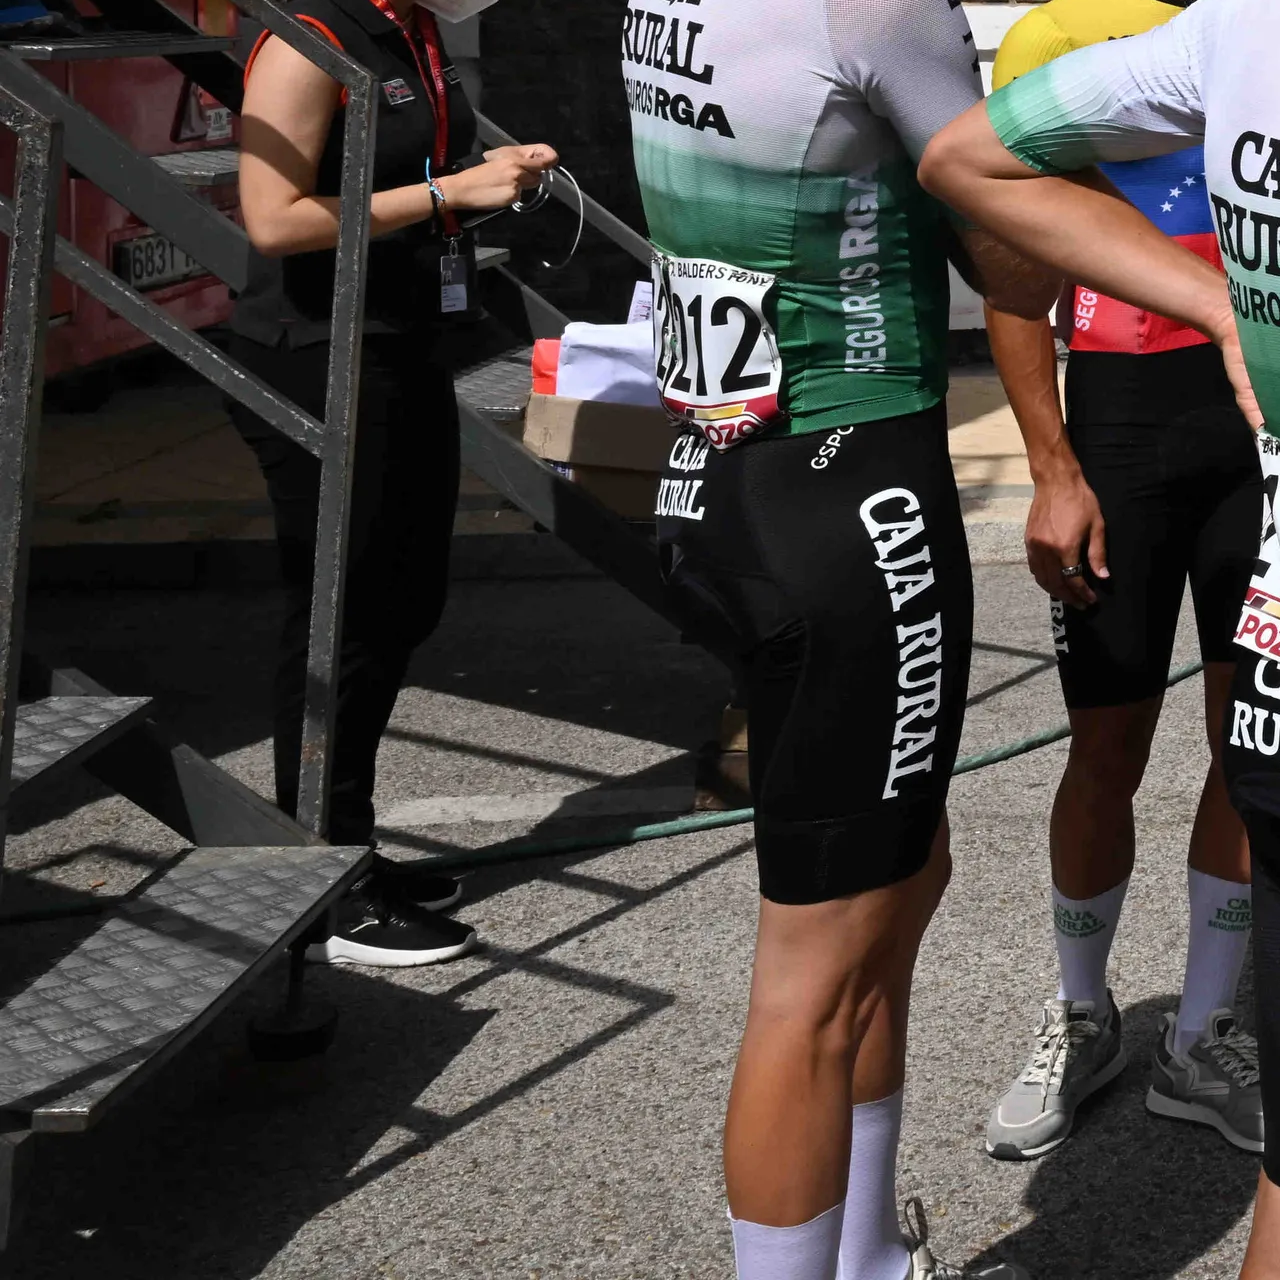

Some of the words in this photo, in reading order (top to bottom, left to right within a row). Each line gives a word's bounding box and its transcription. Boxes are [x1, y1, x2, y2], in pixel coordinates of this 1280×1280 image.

[621, 7, 714, 85] RURAL
[625, 78, 654, 117] GUROS
[654, 86, 736, 139] RGA
[860, 487, 935, 612] CAJA
[1050, 600, 1069, 654] RAL
[881, 612, 942, 801] RURAL
[1216, 908, 1252, 921] RUR
[1227, 898, 1251, 910] CA
